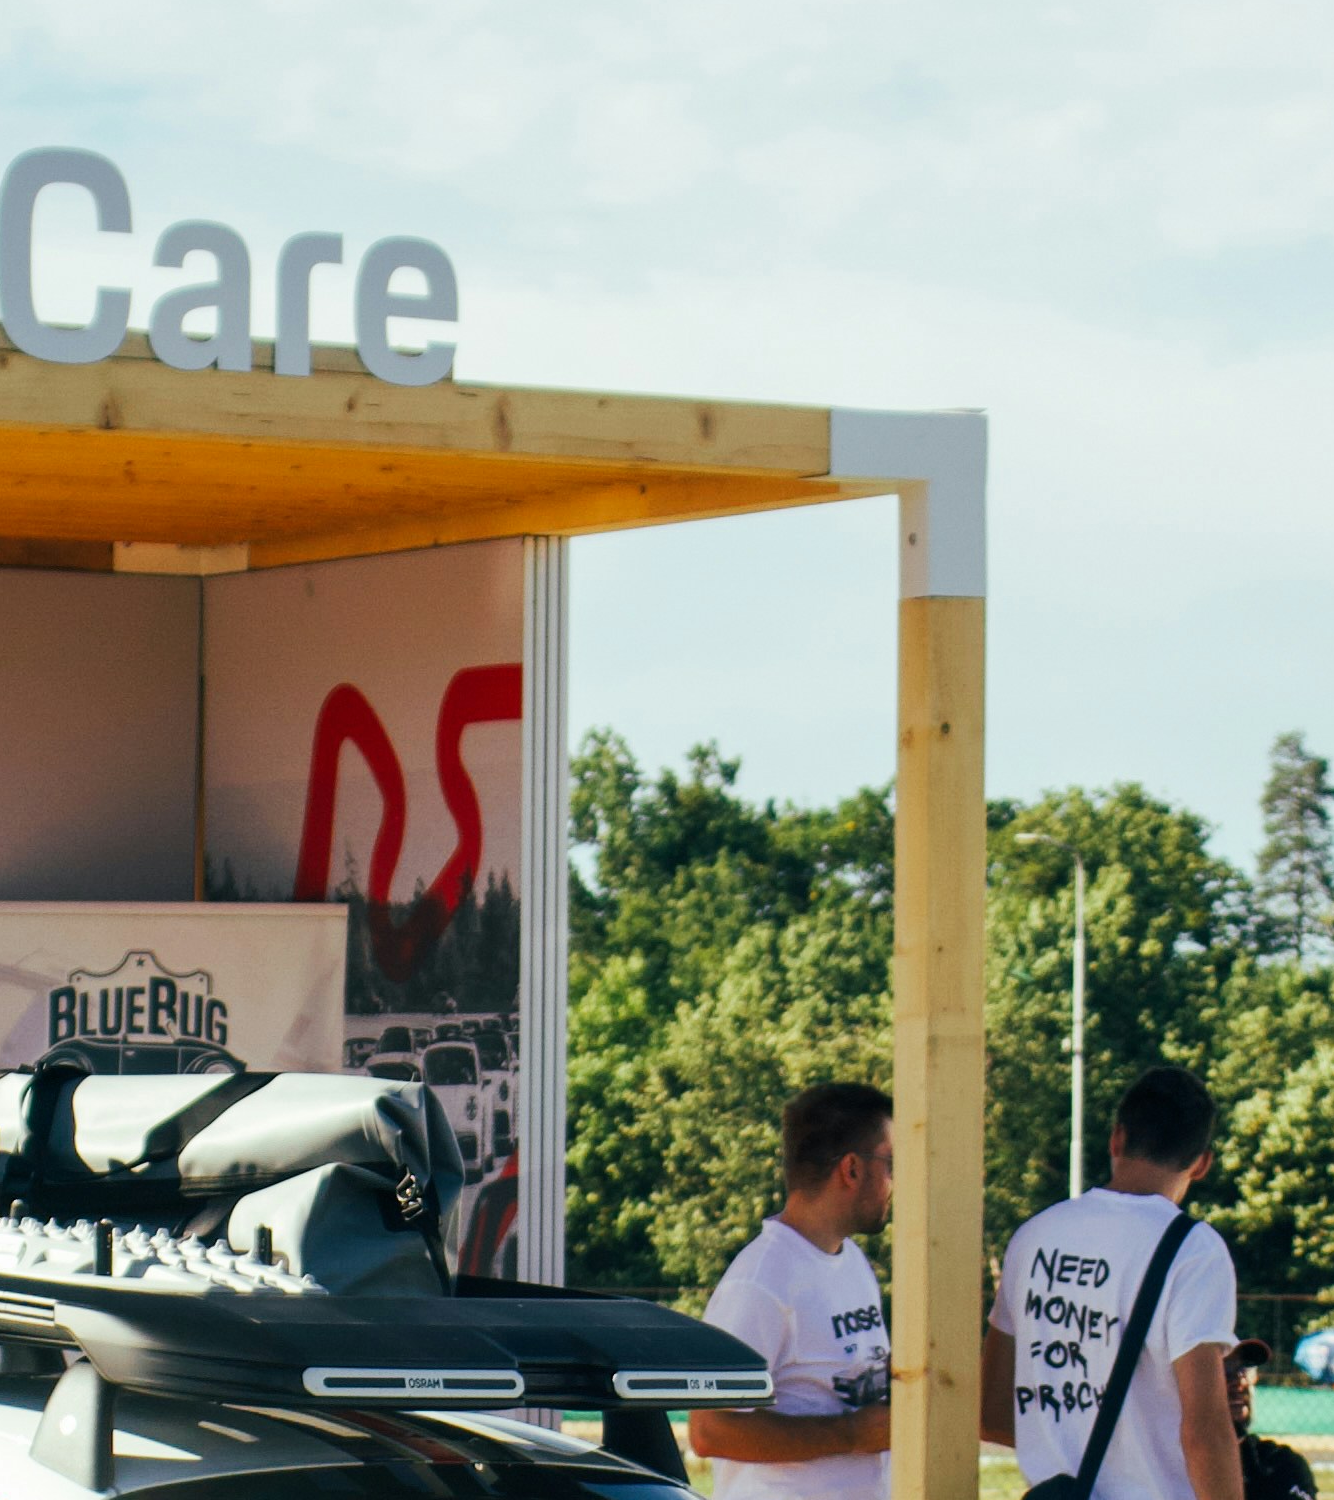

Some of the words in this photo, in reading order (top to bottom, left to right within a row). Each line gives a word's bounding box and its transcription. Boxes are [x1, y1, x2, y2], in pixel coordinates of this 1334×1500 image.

[1031, 1248, 1109, 1292] NEED
[1025, 1288, 1119, 1347] MONEY
[408, 1377, 441, 1389] OSRAM
